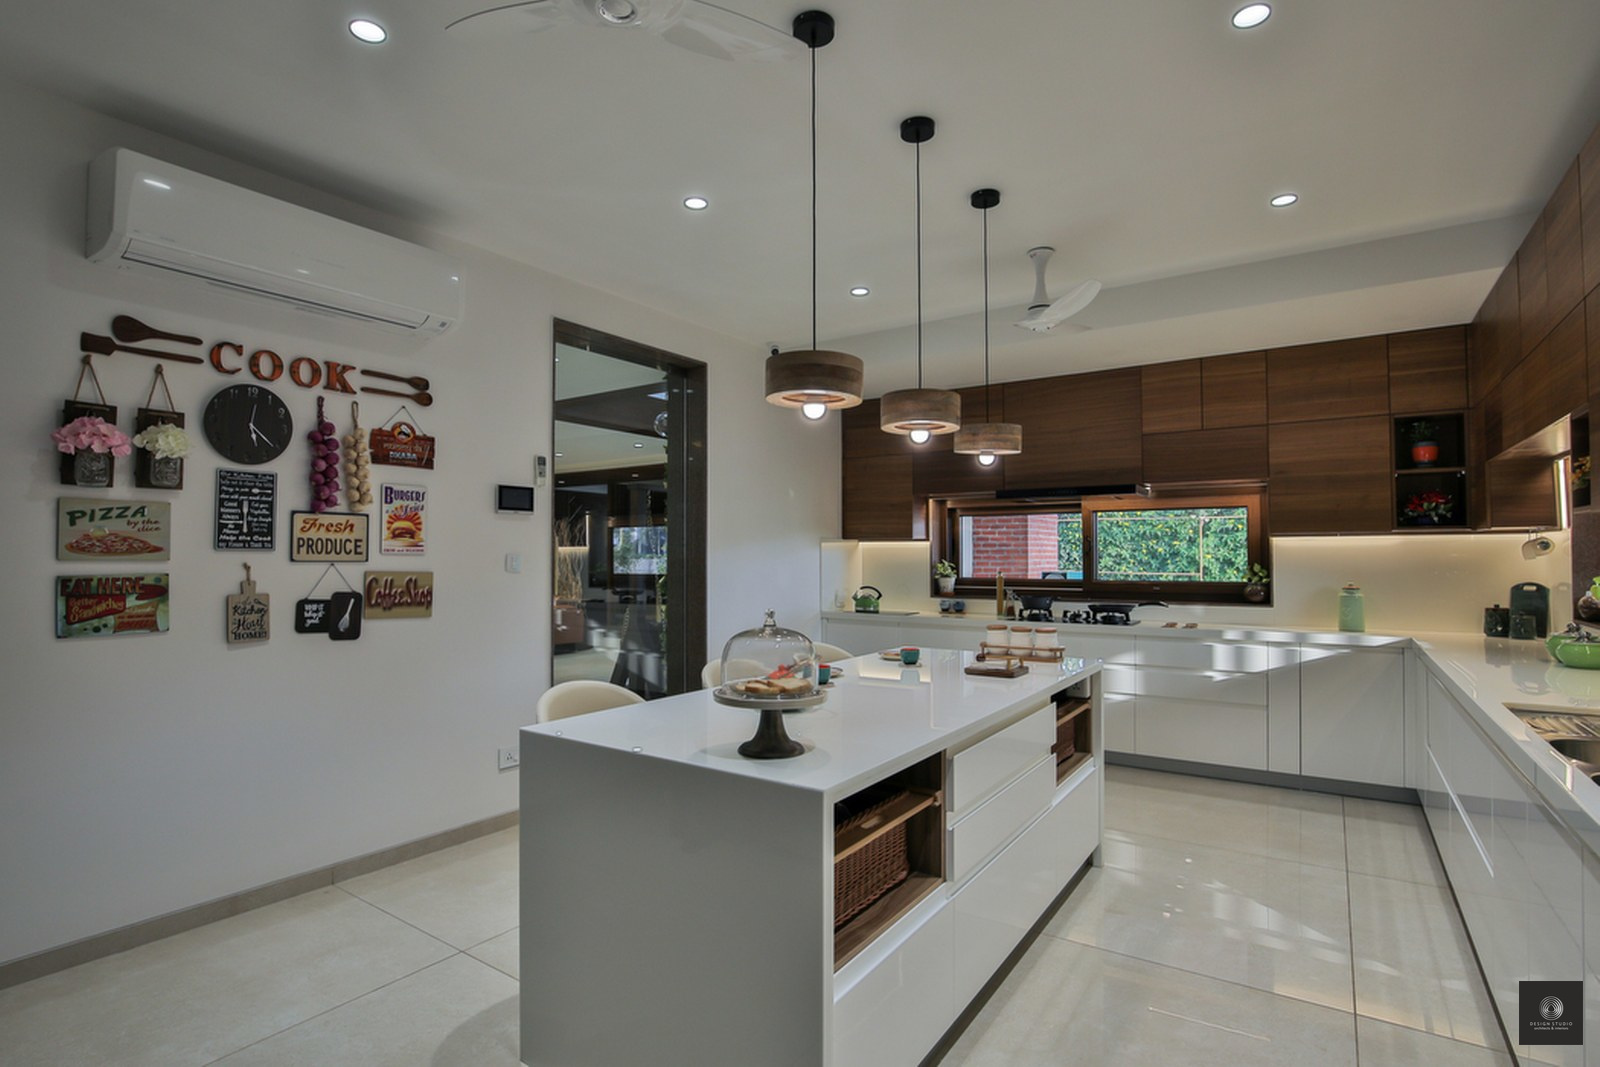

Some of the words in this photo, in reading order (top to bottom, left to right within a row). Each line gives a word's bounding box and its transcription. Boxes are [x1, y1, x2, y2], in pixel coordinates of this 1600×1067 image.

[209, 341, 357, 395] COOK
[384, 486, 426, 505] BURGERS
[66, 505, 147, 527] PIZZA
[300, 518, 354, 534] Fresh
[297, 537, 363, 555] PRODUCE
[61, 578, 93, 597] EAT
[97, 576, 145, 596] HERE
[366, 576, 406, 611] Coffee
[404, 576, 433, 611] Shop
